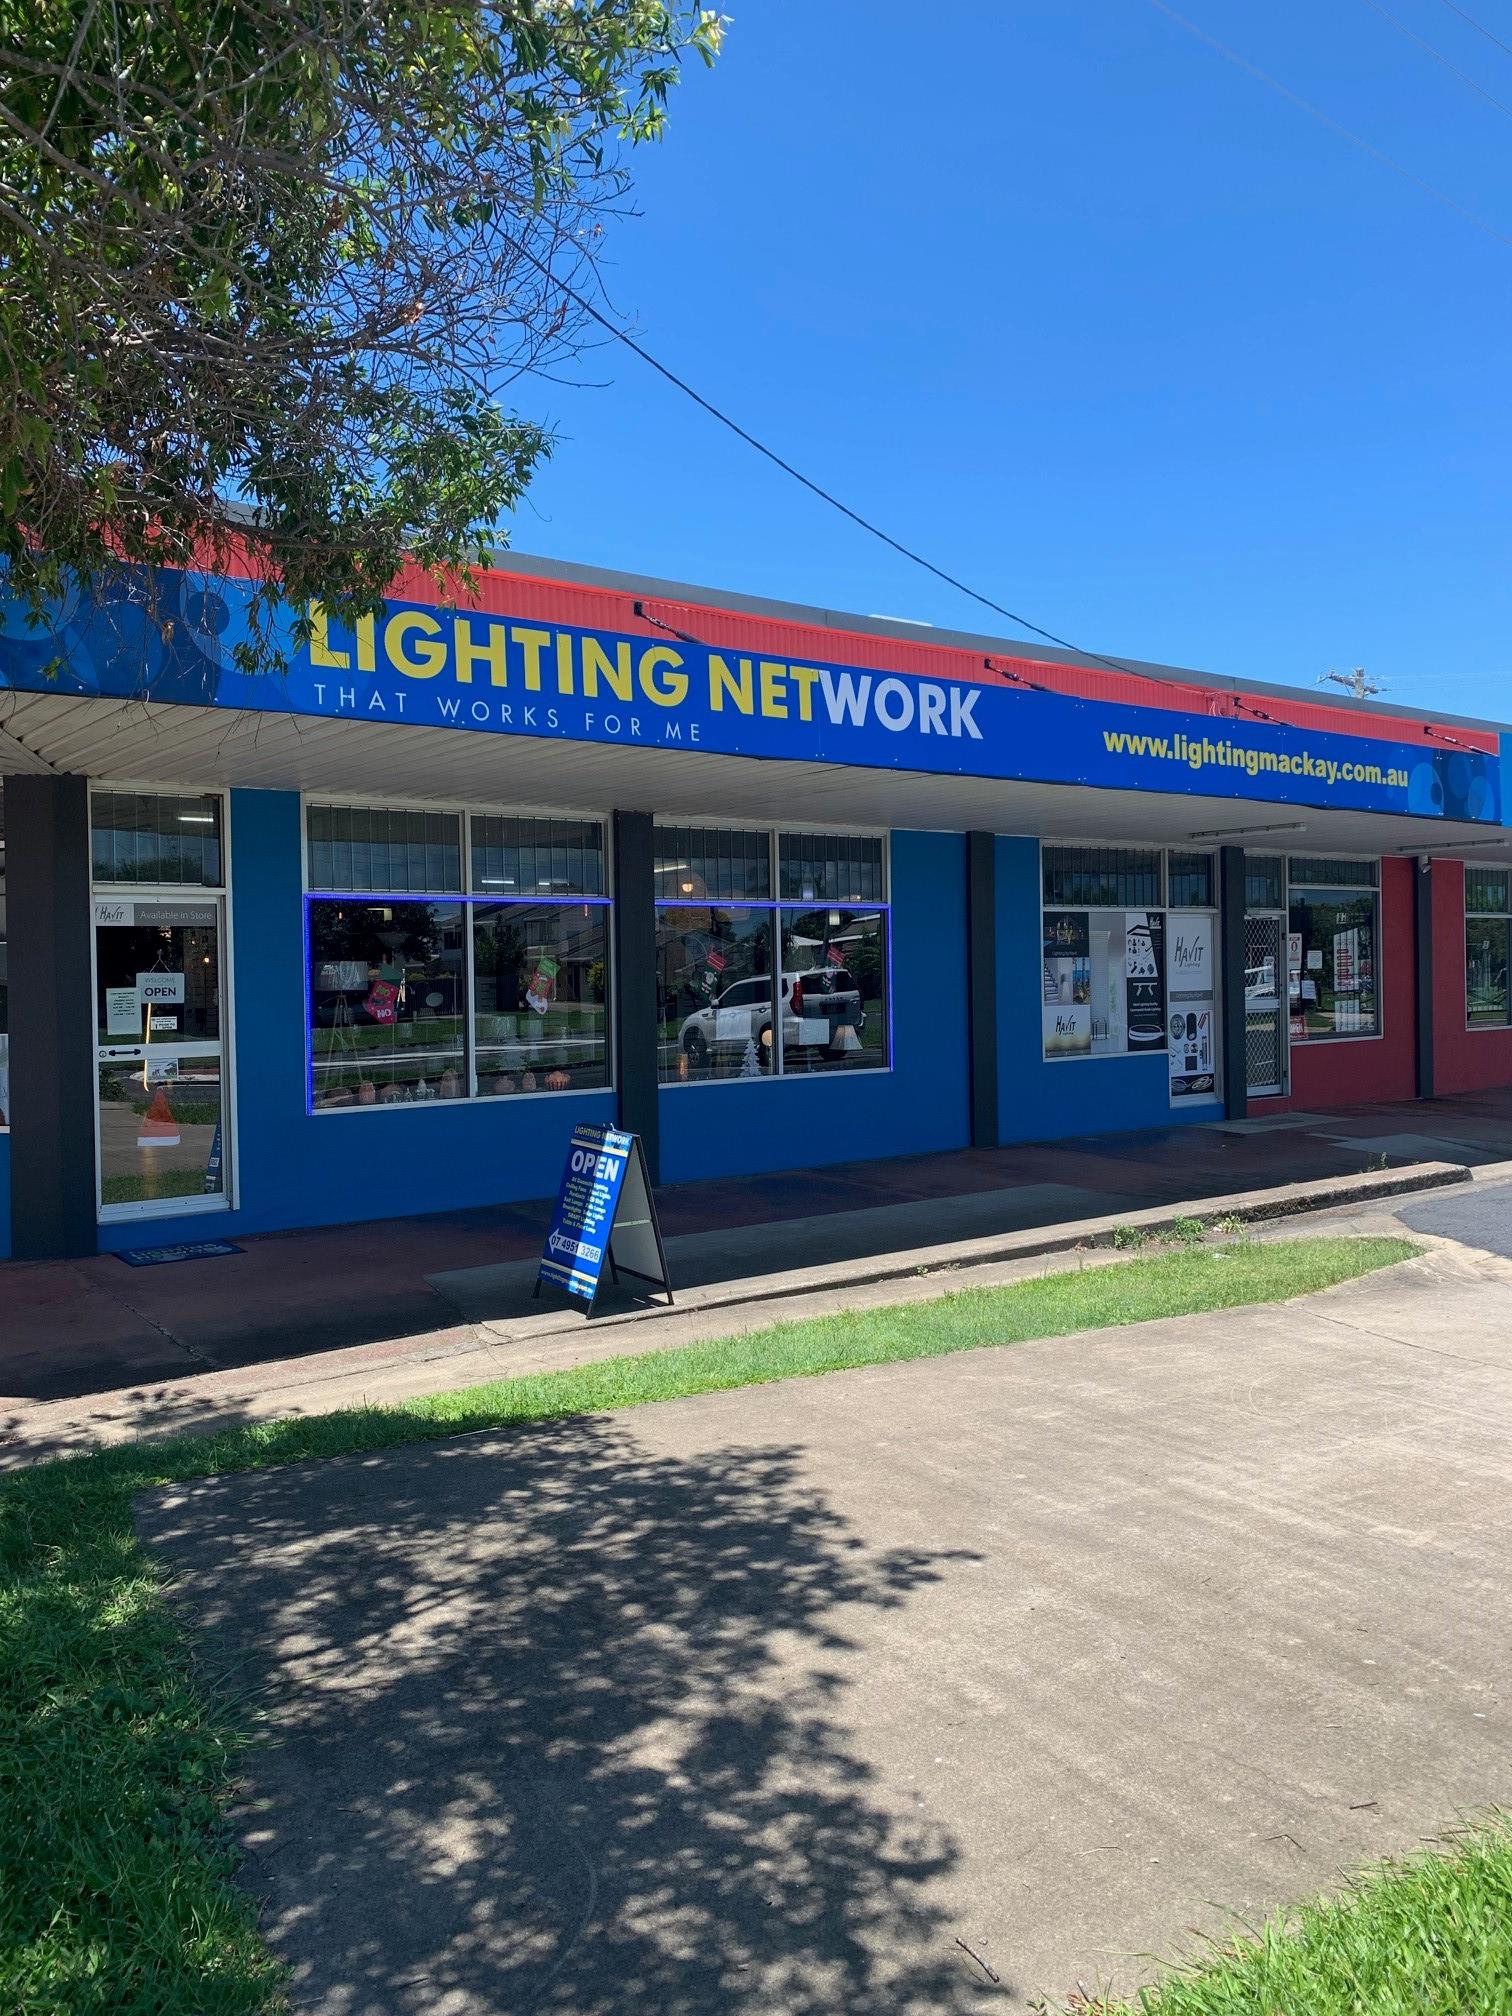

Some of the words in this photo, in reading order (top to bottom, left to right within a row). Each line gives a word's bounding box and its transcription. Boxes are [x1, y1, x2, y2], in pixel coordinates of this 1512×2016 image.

[309, 598, 690, 707] LIGHTING
[708, 654, 984, 740] NETWORK
[313, 683, 407, 713] THAT
[437, 696, 558, 729] WORKS
[585, 712, 641, 737] FOR
[665, 721, 700, 742] ME
[1103, 730, 1409, 788] www.lightingmackay.com.au
[141, 910, 178, 920] Available
[180, 910, 189, 920] in
[190, 910, 213, 920] Store
[145, 987, 176, 996] OPEN
[377, 1009, 391, 1018] HO
[575, 1126, 601, 1139] LIGHTING
[571, 1150, 620, 1183] OPEN
[551, 1234, 562, 1247] 07
[561, 1239, 580, 1255] 4951
[580, 1245, 599, 1260] 3266
